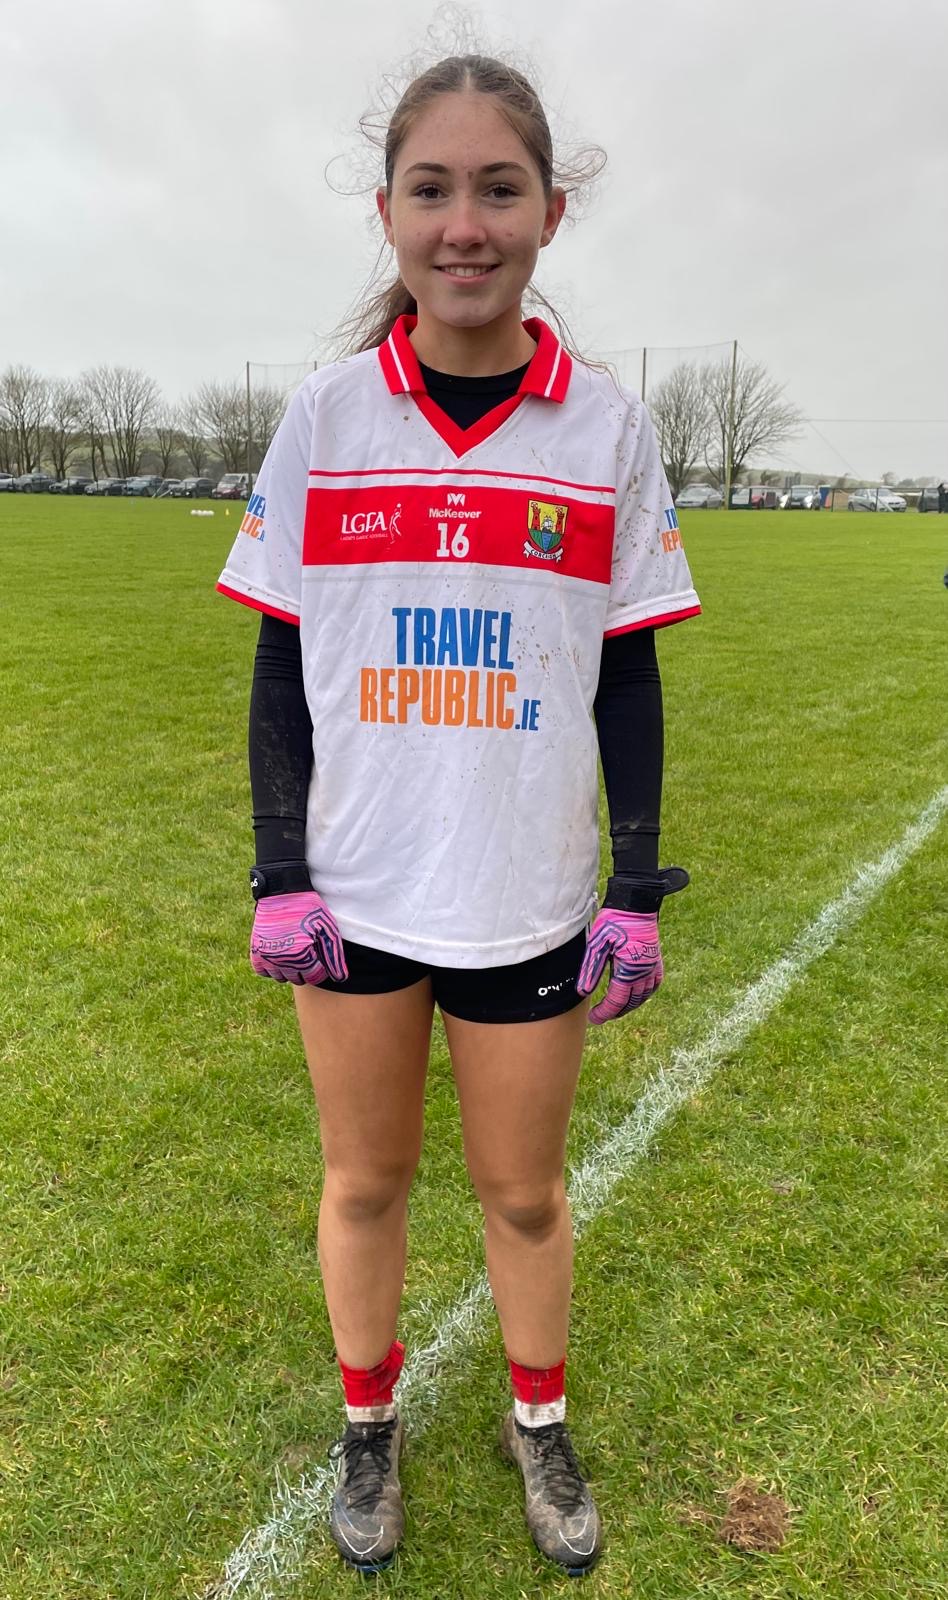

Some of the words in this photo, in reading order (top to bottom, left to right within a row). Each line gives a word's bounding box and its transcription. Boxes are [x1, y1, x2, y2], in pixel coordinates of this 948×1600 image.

[341, 511, 388, 534] LGFA
[429, 508, 482, 519] McKeever
[436, 522, 470, 558] 16
[392, 607, 514, 669] TRAVEL
